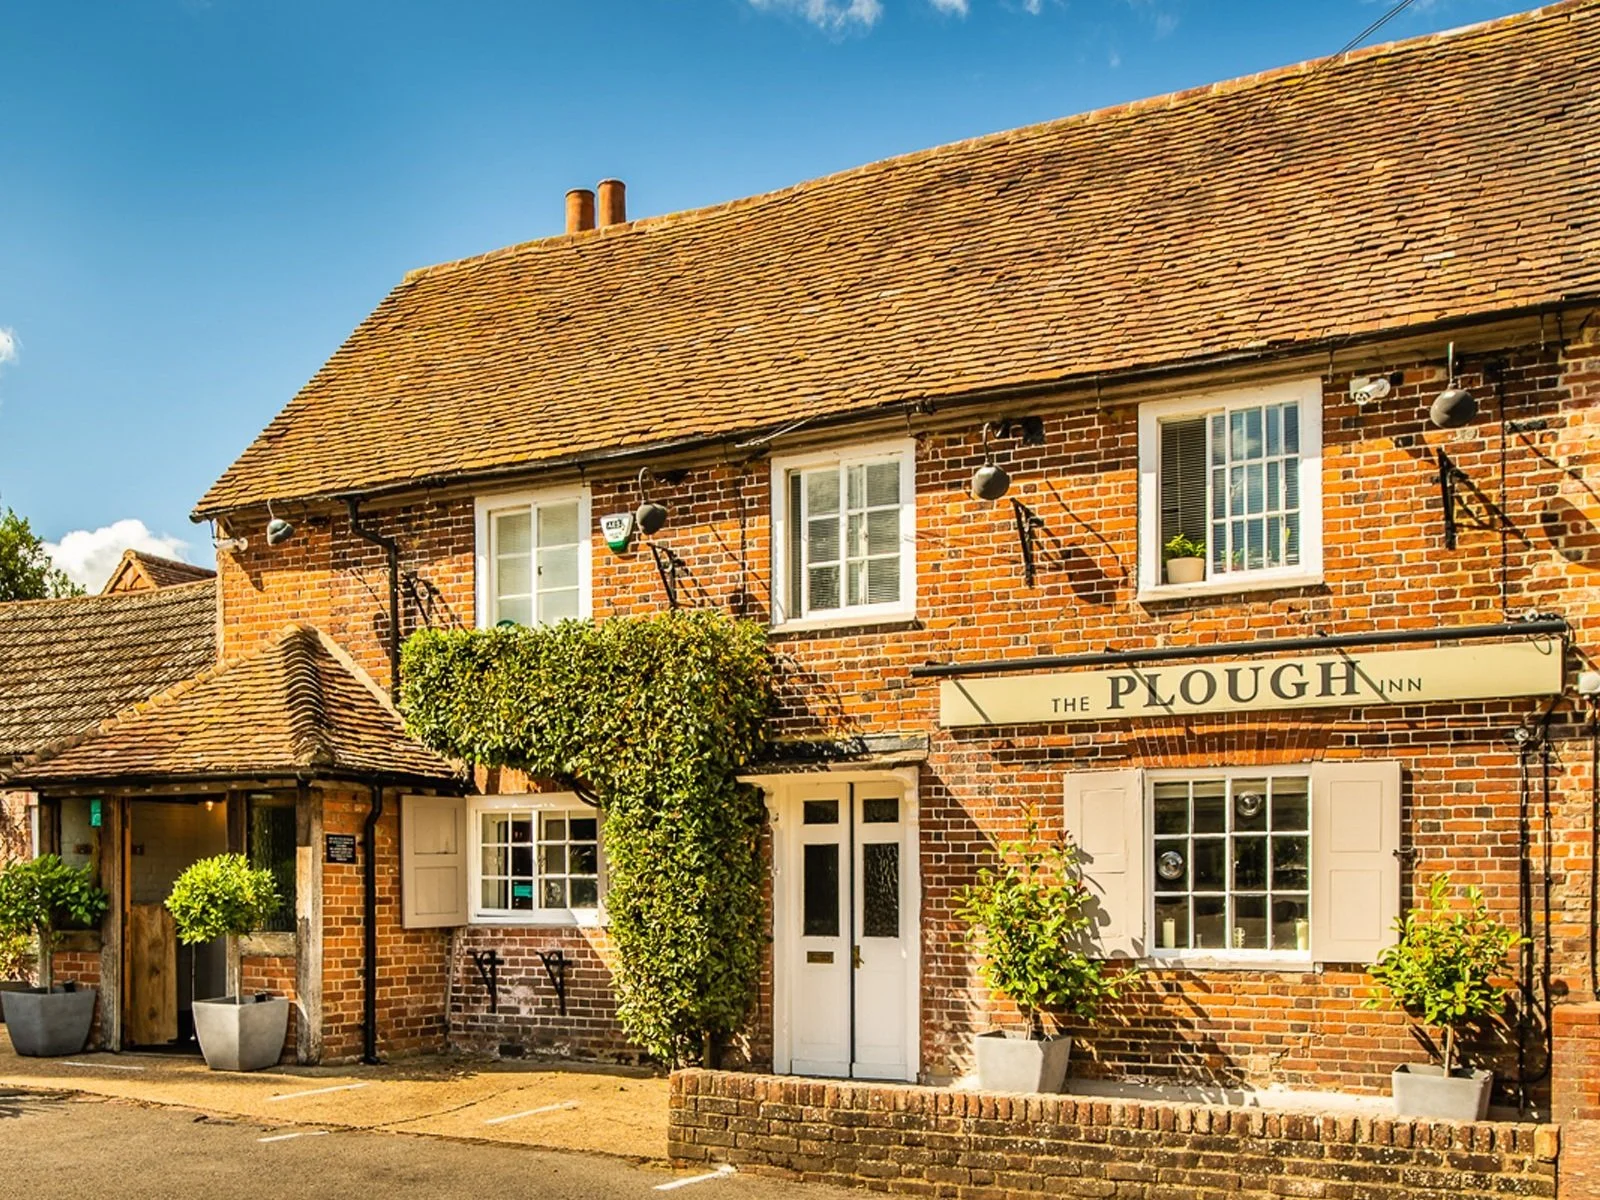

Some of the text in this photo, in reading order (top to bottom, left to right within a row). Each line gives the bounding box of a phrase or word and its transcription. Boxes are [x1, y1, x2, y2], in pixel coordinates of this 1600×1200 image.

[1052, 660, 1422, 713] THE PLOUGH INN
